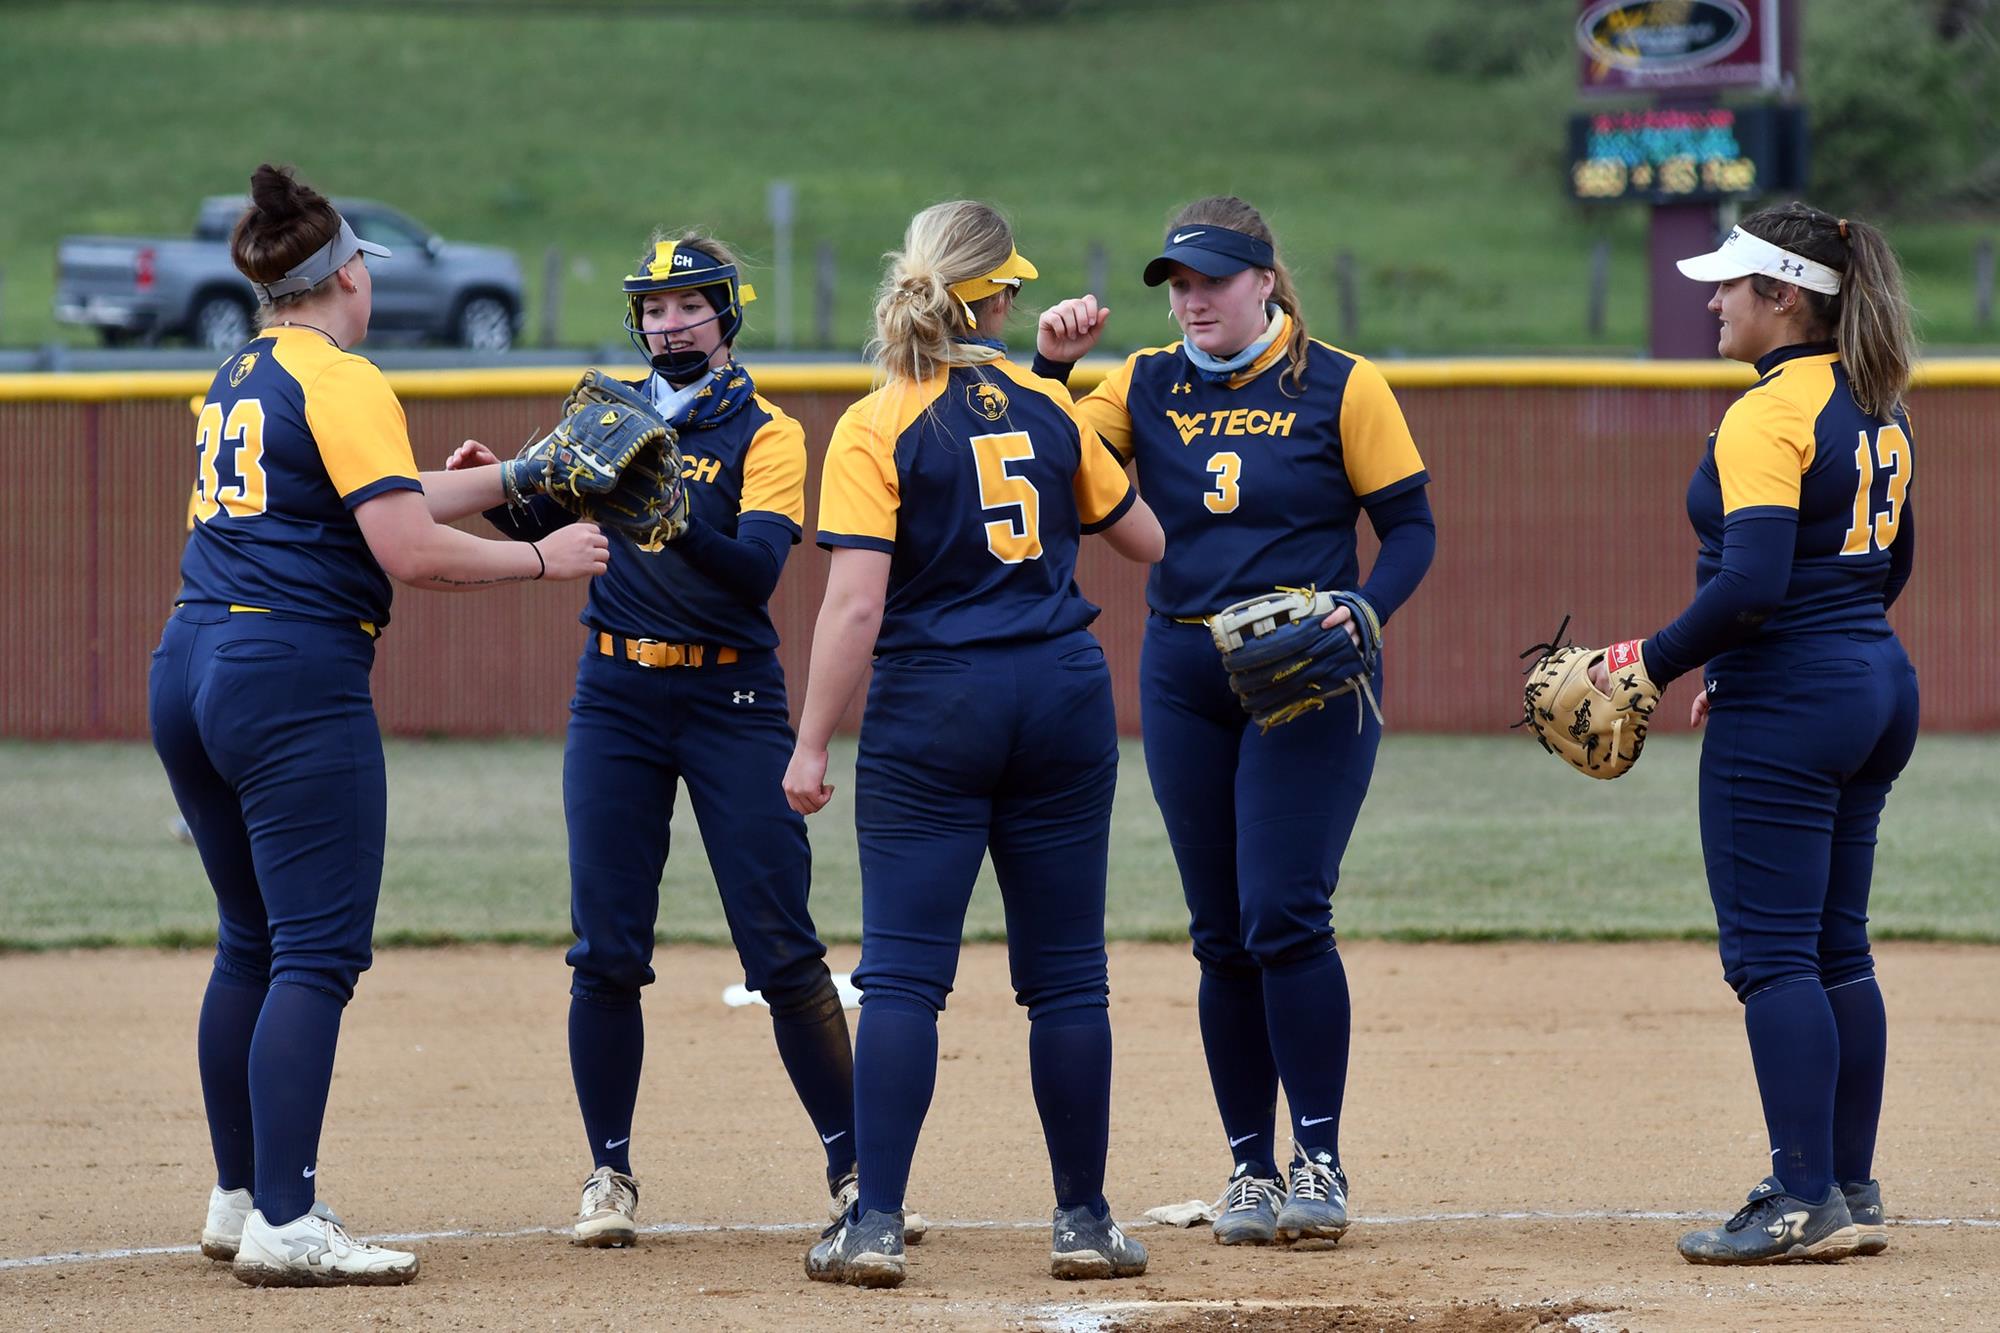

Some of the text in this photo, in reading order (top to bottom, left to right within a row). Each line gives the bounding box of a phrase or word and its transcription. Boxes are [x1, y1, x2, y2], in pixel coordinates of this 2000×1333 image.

[672, 254, 693, 268] CH
[1210, 408, 1297, 436] TECH
[195, 399, 267, 524] 33
[681, 454, 722, 484] CH
[1203, 452, 1242, 514] 3
[1839, 424, 1912, 555] 13
[969, 431, 1043, 564] 5
